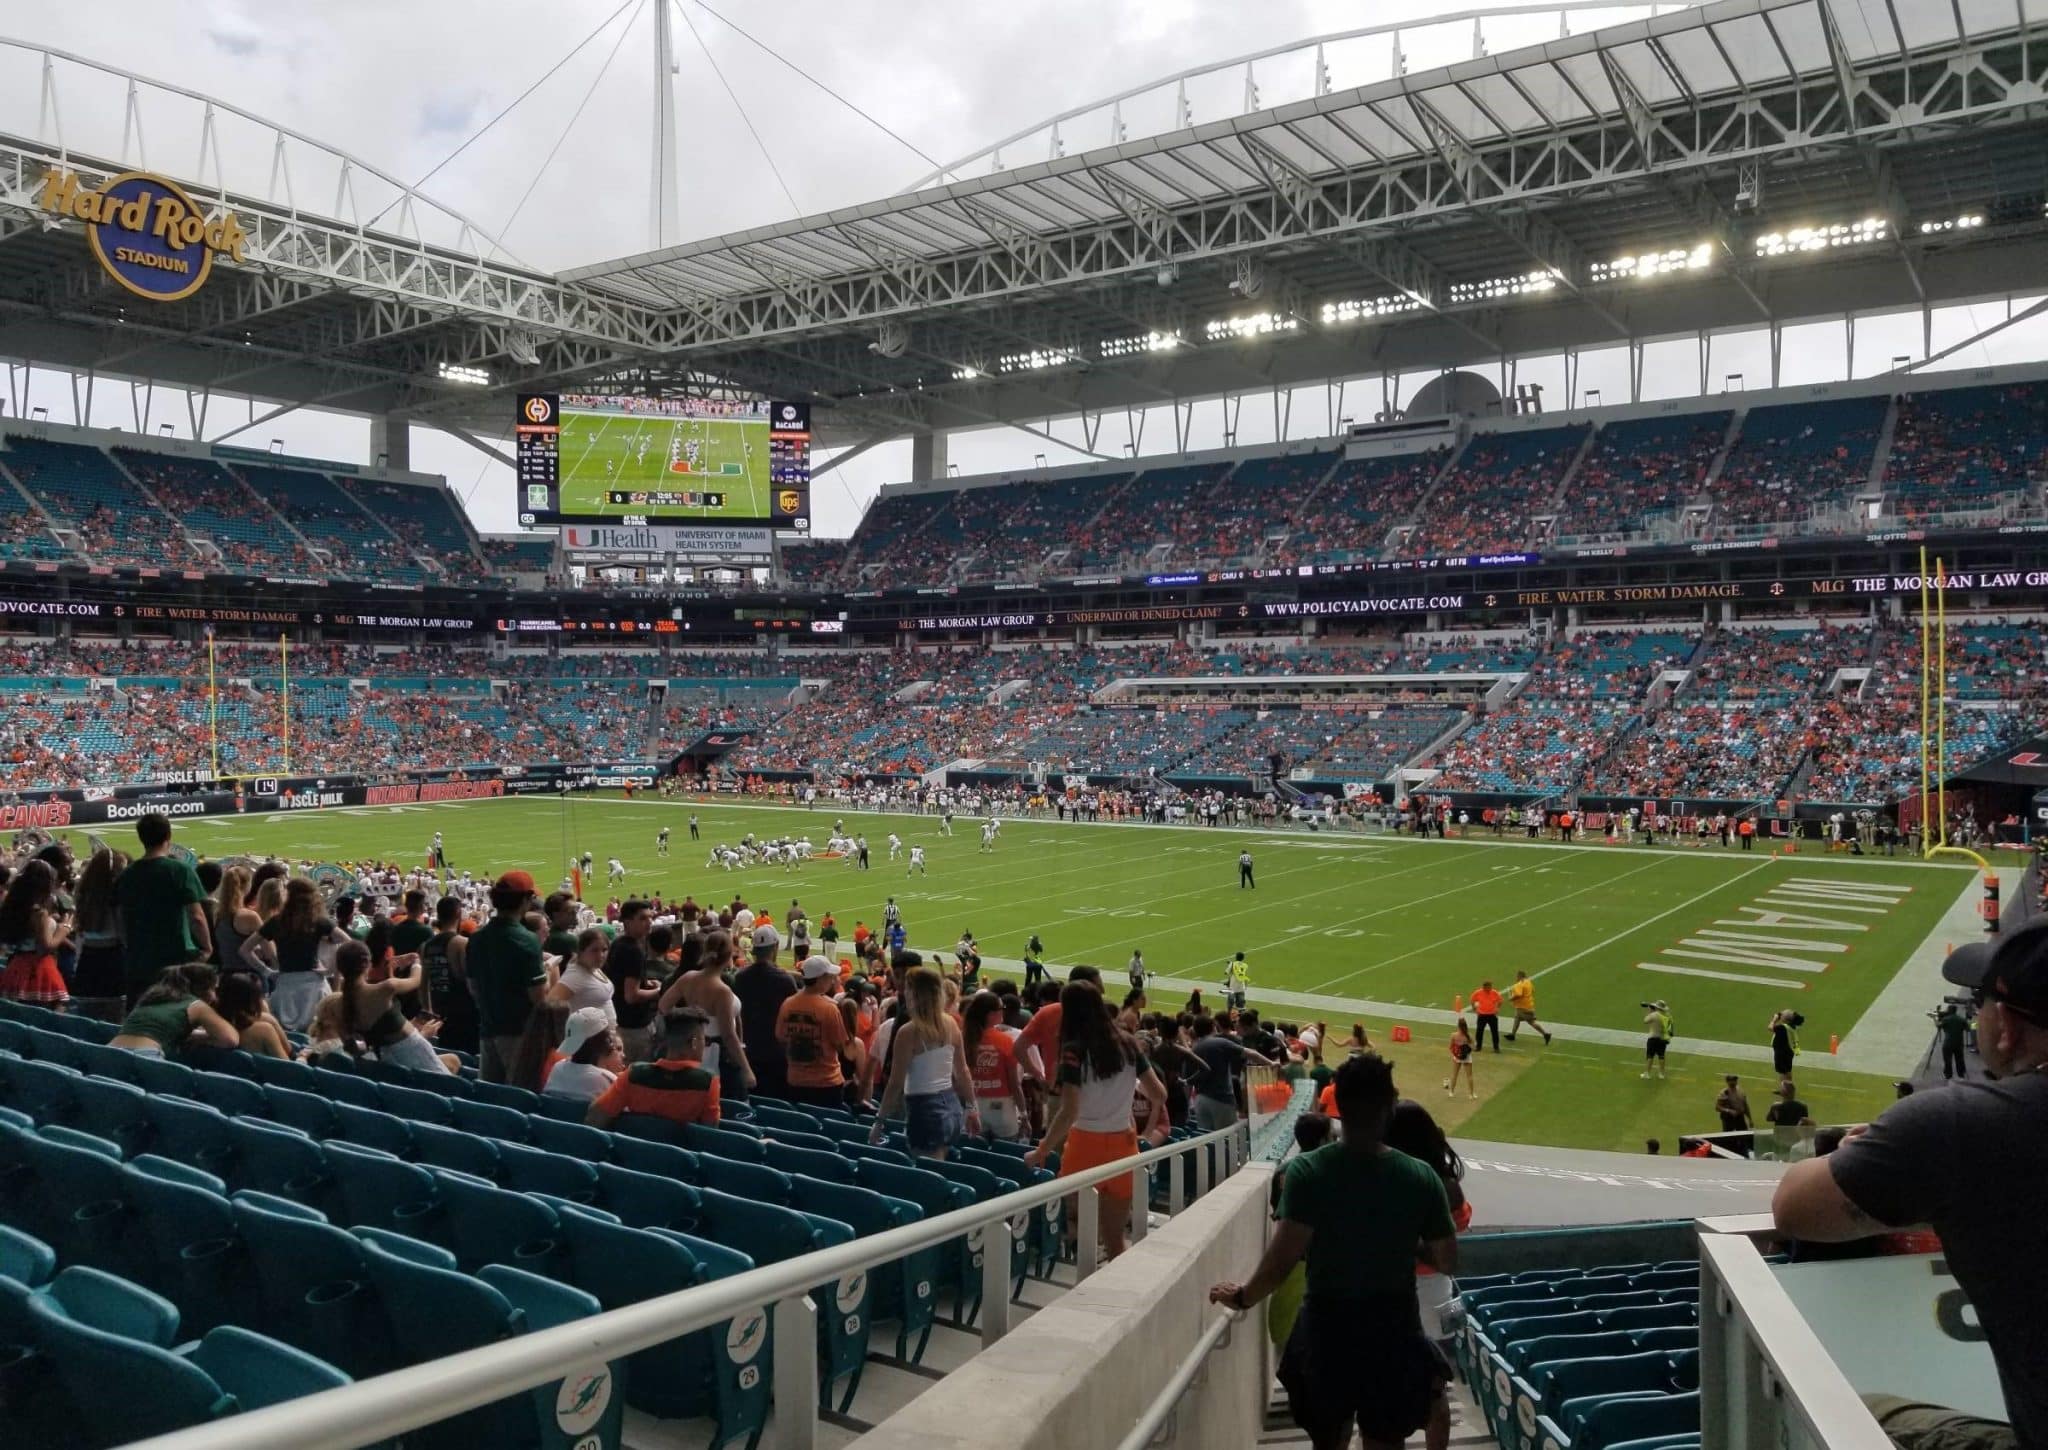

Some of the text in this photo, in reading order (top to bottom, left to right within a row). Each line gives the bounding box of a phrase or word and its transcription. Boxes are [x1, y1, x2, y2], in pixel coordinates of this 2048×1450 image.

[41, 171, 245, 262] Hard Rock
[116, 248, 188, 273] STADIUM
[615, 495, 622, 503] 0
[711, 496, 717, 504] 0
[783, 497, 798, 509] ups
[675, 531, 766, 540] UNIVERSITY OF MIAMI
[1884, 533, 1906, 541] OTTO
[675, 541, 742, 549] HEALTH SYSTEM
[1691, 540, 1761, 551] CORTEZ KENNEDY
[1812, 580, 1845, 593] MLG
[1852, 578, 1886, 592] THE
[1980, 573, 2023, 588] LAW
[1614, 587, 1665, 601] STORM
[1671, 584, 1744, 599] DAMAGE.
[1265, 596, 1463, 615] WWW.POLICYADVOCATE.COM
[212, 609, 250, 620] STORM
[1067, 606, 1222, 623] UNDERPAID OR DENIED CLAIM?
[357, 615, 376, 625] THE
[379, 616, 420, 627] MORGAN
[423, 618, 443, 628] LAW
[444, 619, 473, 629] GROUP
[919, 619, 935, 629] THE
[938, 617, 978, 628] MORGAN
[981, 616, 1001, 627] LAW
[1002, 614, 1034, 625] GROUP
[263, 781, 274, 791] 14
[597, 777, 653, 786] GEICO
[320, 792, 344, 805] MILK
[107, 801, 204, 820] Booking.com
[1636, 877, 1913, 989] MIAMI
[918, 1283, 929, 1295] 27
[847, 1318, 858, 1331] 28
[743, 1369, 755, 1385] 29
